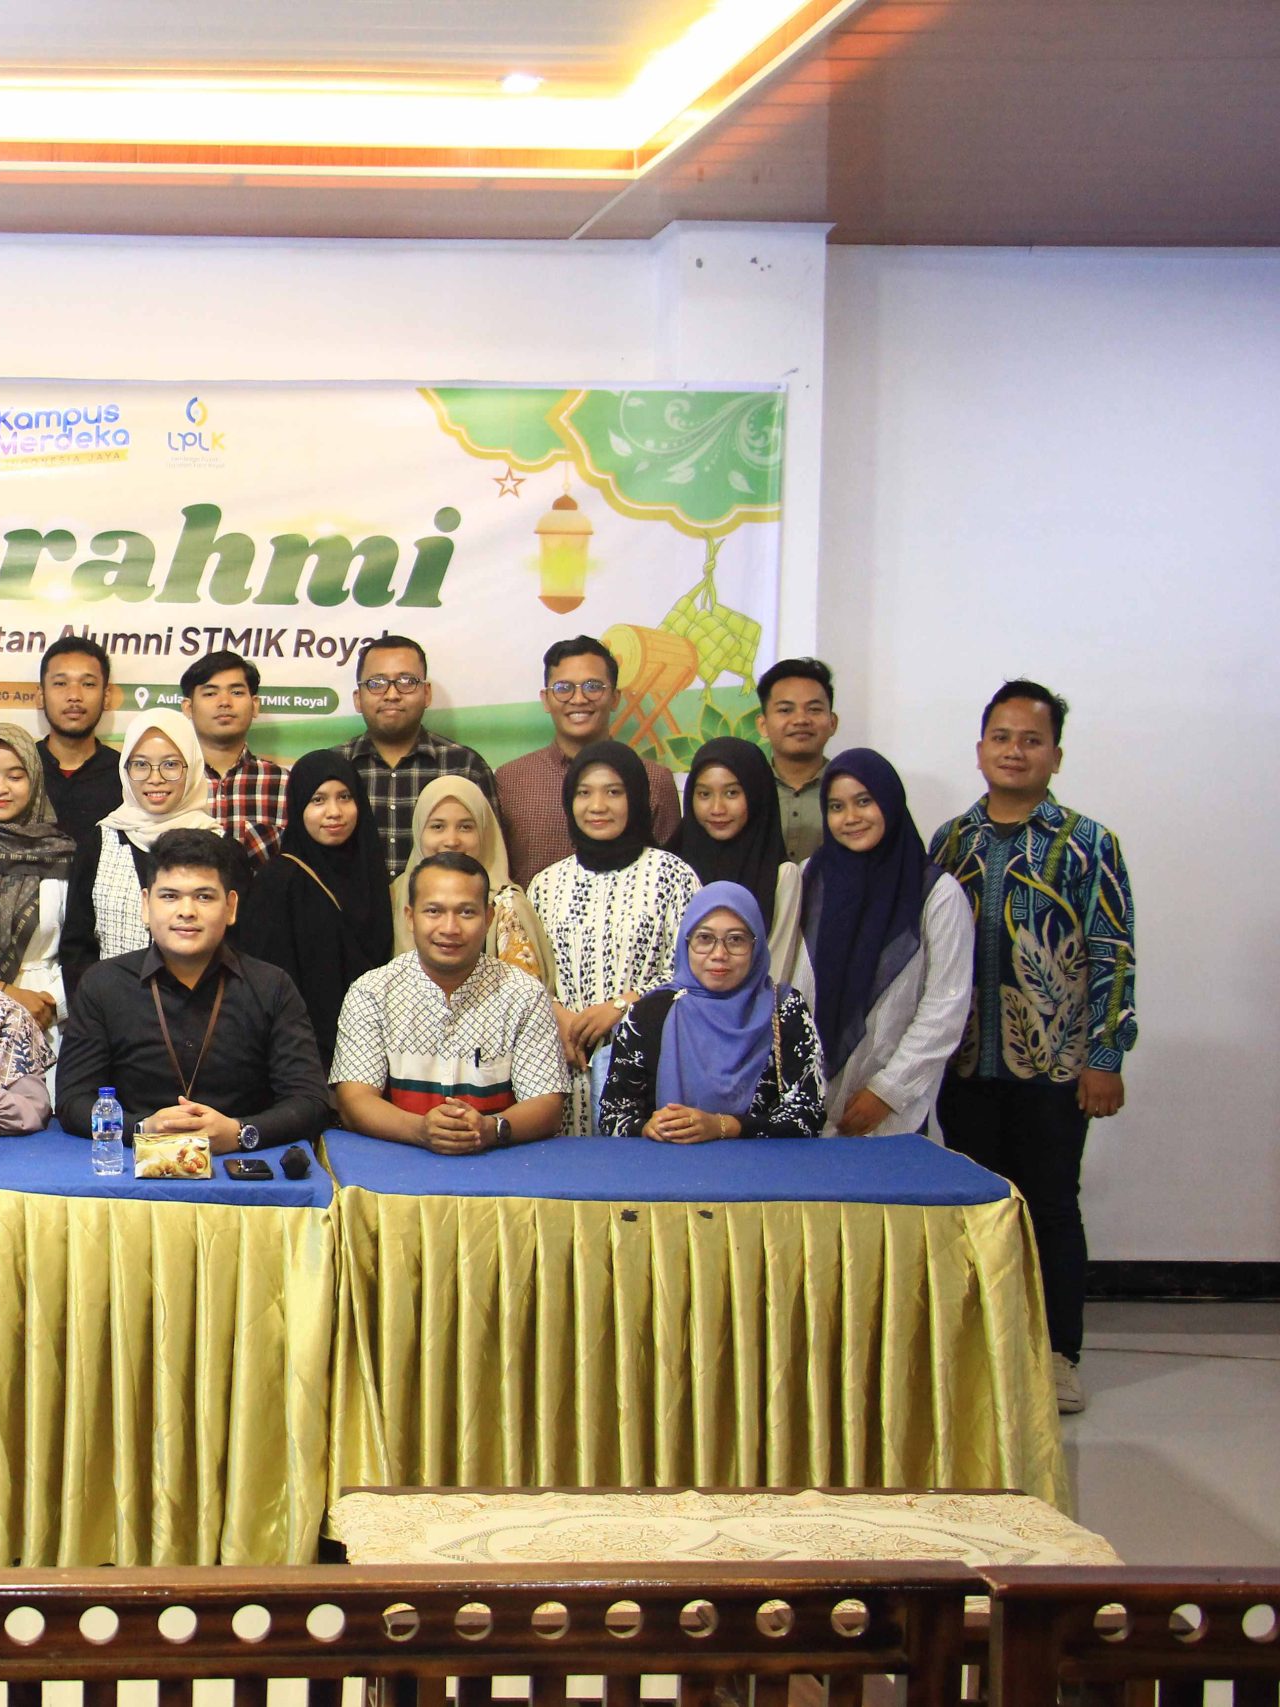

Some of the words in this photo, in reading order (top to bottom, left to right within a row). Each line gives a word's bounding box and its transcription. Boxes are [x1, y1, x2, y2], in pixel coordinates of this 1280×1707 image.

[3, 454, 80, 466] NDONESIA
[179, 626, 287, 658] STMIK
[293, 629, 388, 667] Roya
[13, 691, 35, 703] Apr
[156, 693, 184, 704] Aula
[258, 695, 291, 706] TMIK
[294, 696, 328, 709] Royal
